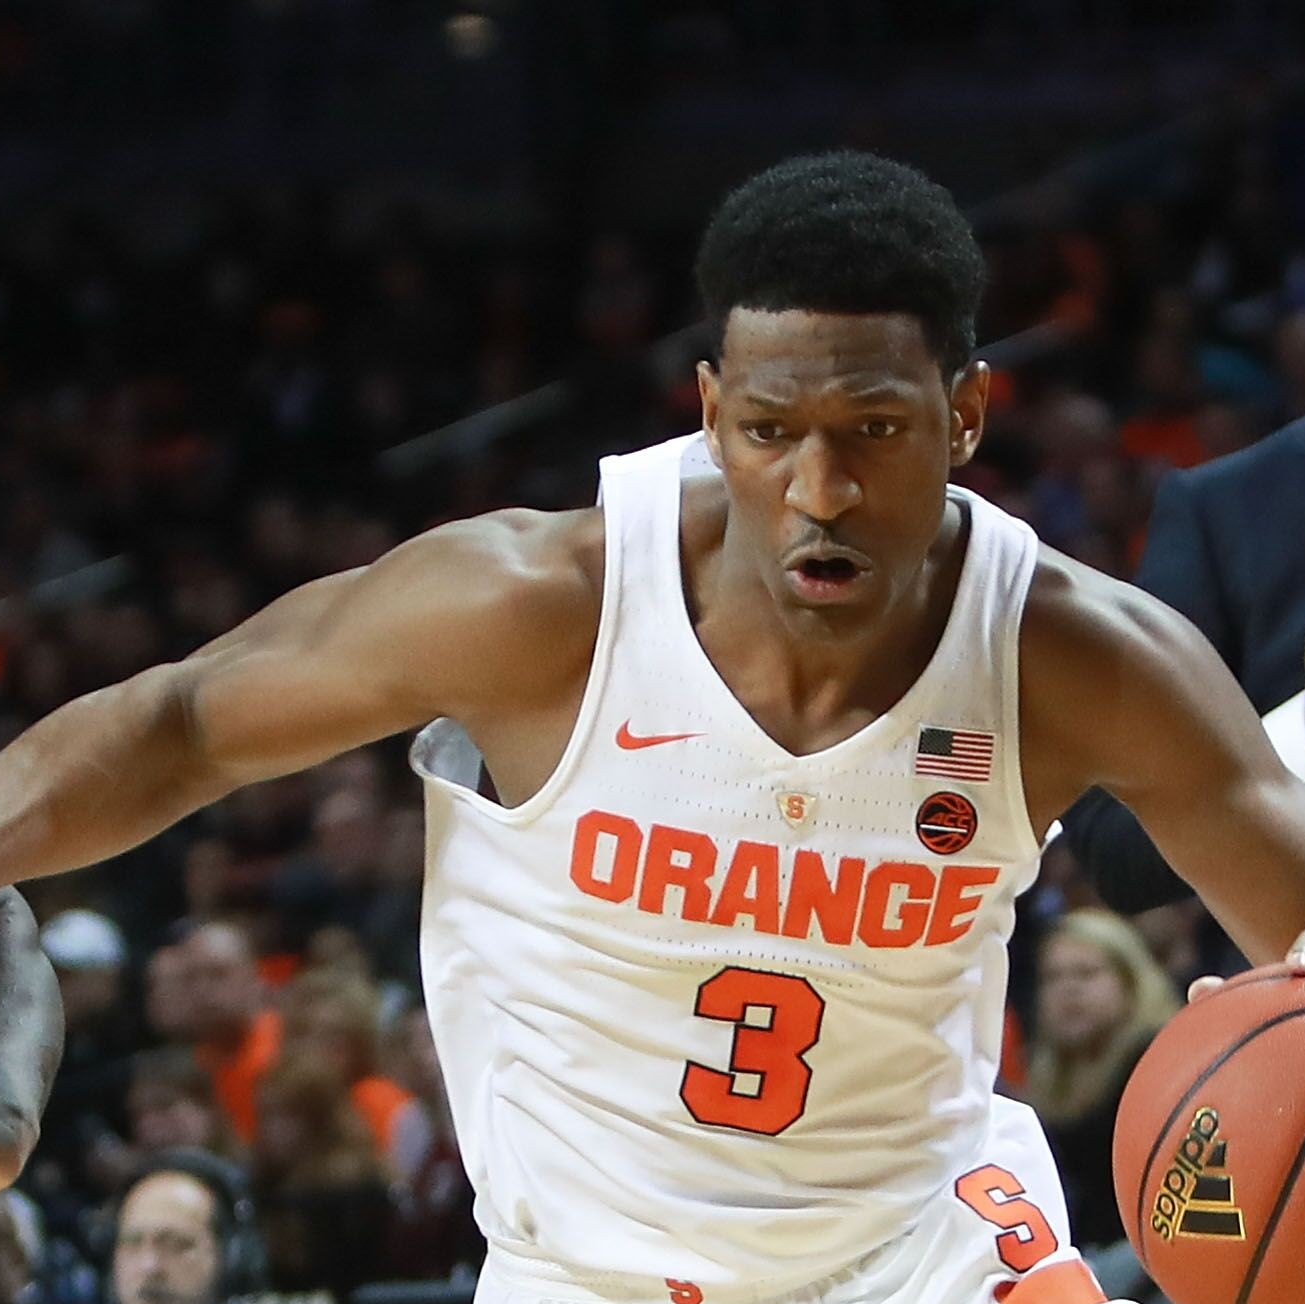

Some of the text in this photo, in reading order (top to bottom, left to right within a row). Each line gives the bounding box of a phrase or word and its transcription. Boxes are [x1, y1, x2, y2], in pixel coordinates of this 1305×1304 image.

[569, 808, 1001, 949] ORANGE
[679, 965, 826, 1137] 3
[954, 1162, 1059, 1274] S
[1151, 1106, 1219, 1241] adidas
